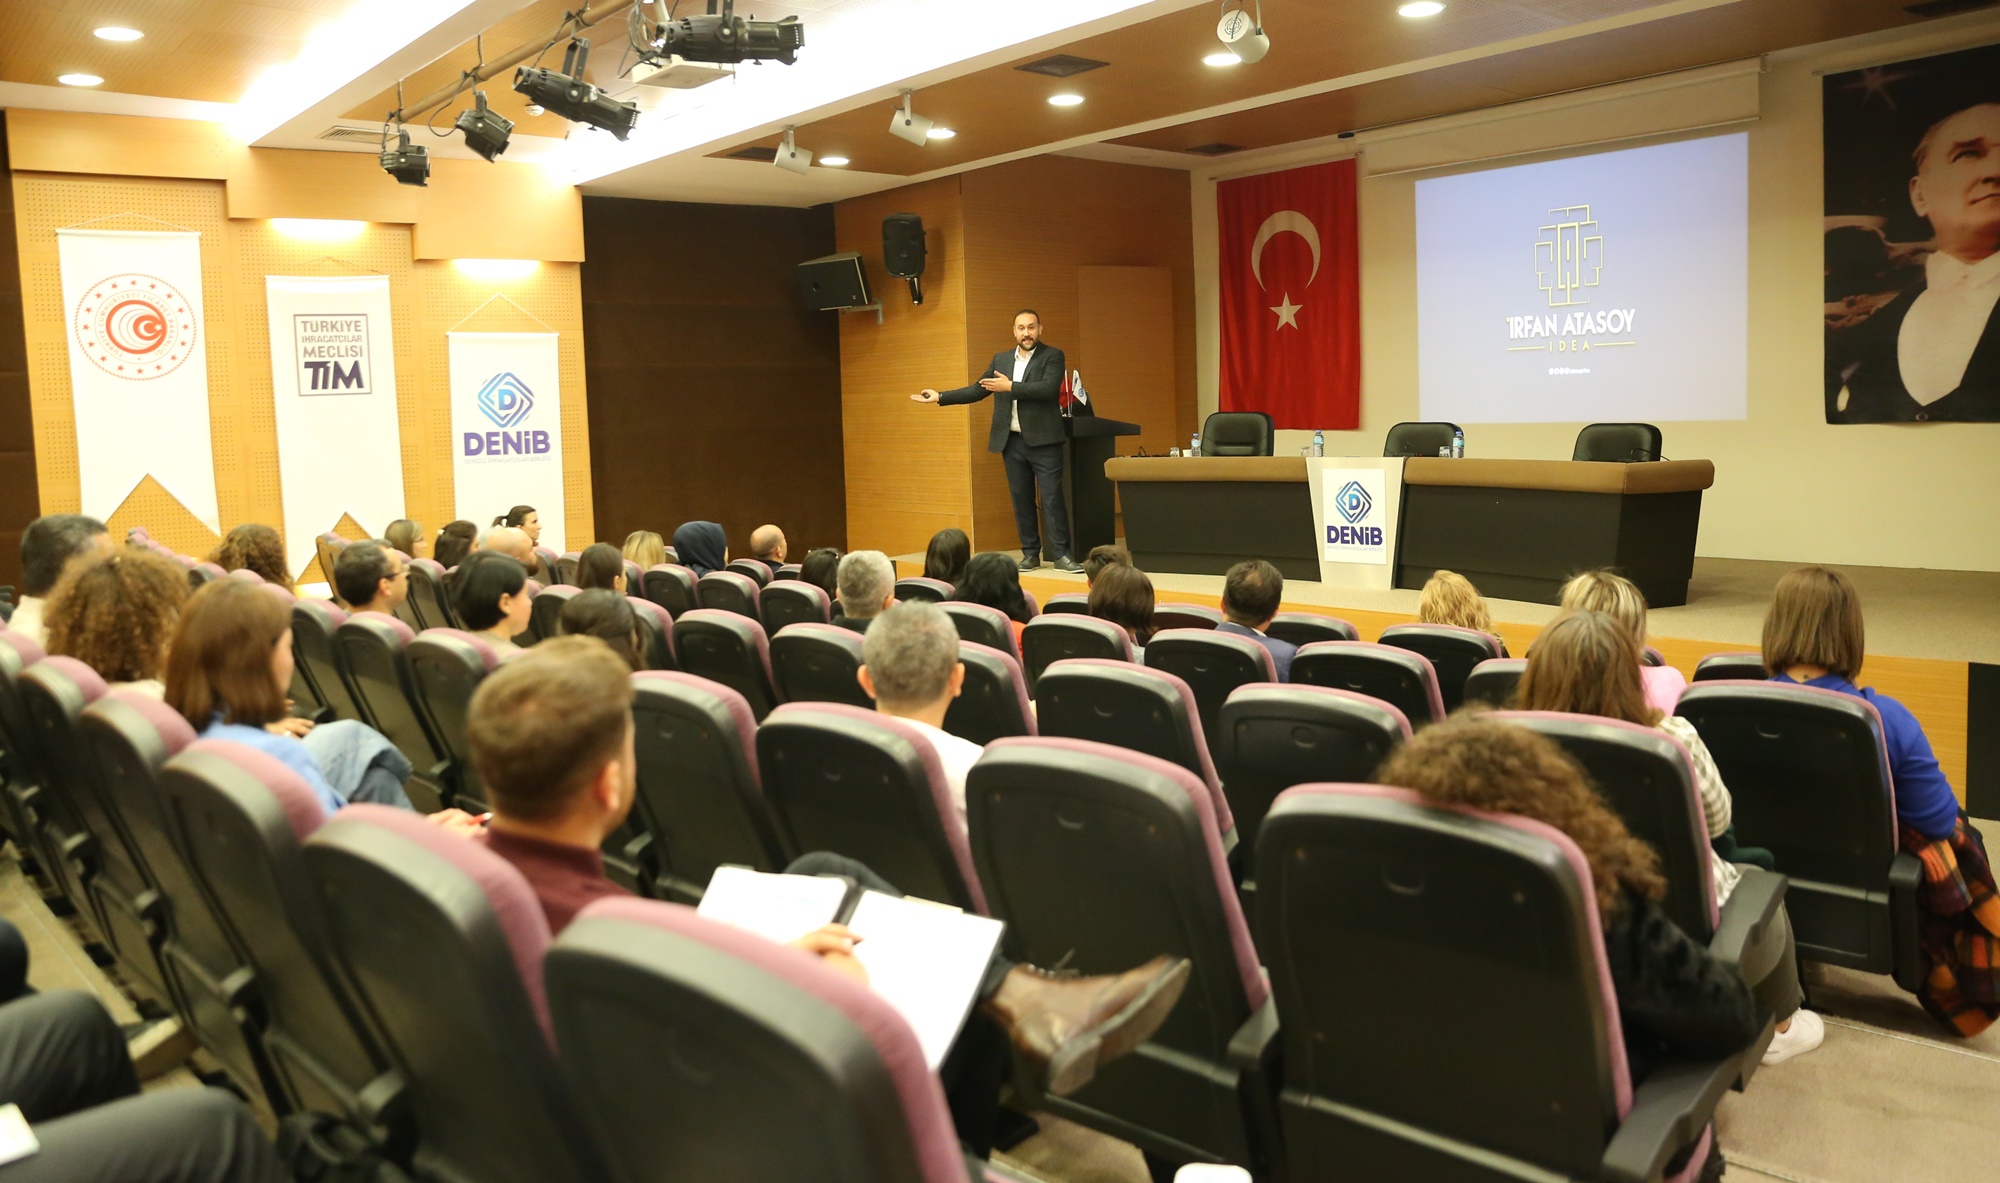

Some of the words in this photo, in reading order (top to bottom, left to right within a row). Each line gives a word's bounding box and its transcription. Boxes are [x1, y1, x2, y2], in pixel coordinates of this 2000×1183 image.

[301, 320, 362, 333] TÜRKİYE
[1561, 308, 1636, 336] ATASOY
[1549, 339, 1591, 352] IDEA
[498, 389, 518, 411] D
[1348, 494, 1361, 511] D
